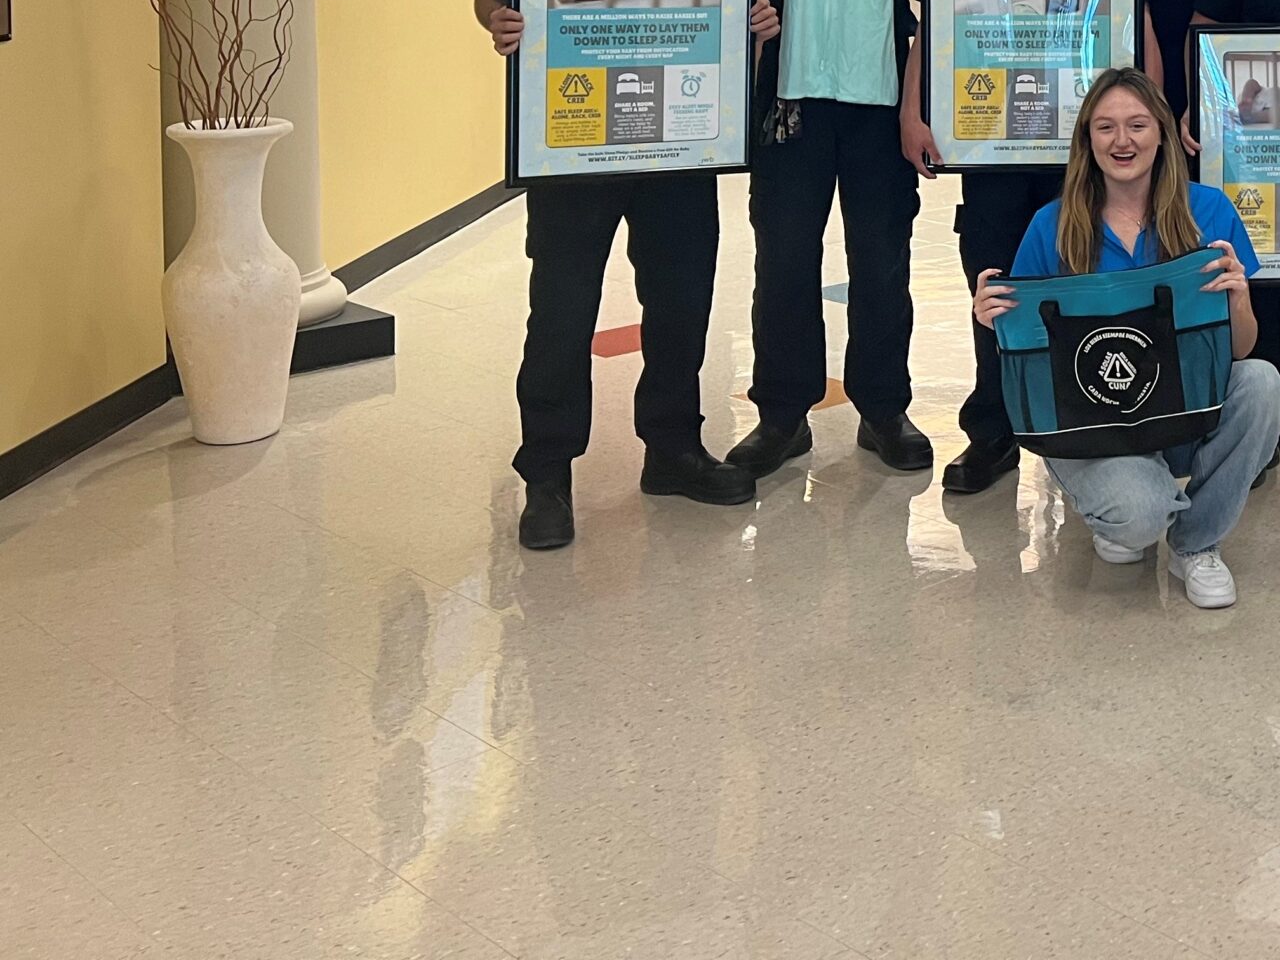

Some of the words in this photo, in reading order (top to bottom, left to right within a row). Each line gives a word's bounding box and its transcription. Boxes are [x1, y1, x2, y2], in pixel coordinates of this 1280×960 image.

[560, 25, 588, 35] ONLY
[591, 25, 613, 35] ONE
[615, 24, 640, 34] WAY
[642, 24, 657, 33] TO
[659, 24, 678, 33] LAY
[679, 23, 709, 33] THEM
[965, 30, 990, 38] ONLY
[992, 30, 1013, 38] ON
[1014, 30, 1037, 38] WAY
[1039, 30, 1050, 38] TO
[1072, 30, 1099, 38] THM
[574, 37, 609, 46] DOWN
[611, 36, 626, 46] TO
[628, 36, 658, 45] SLEEP
[660, 34, 697, 44] SAFELY
[977, 41, 1009, 49] DOWN
[1011, 41, 1023, 49] TO
[1234, 145, 1259, 154] ONLY
[1261, 145, 1280, 153] ONE
[1246, 156, 1277, 164] DOWN
[1100, 351, 1112, 371] SOLAS
[1088, 385, 1101, 399] CADA
